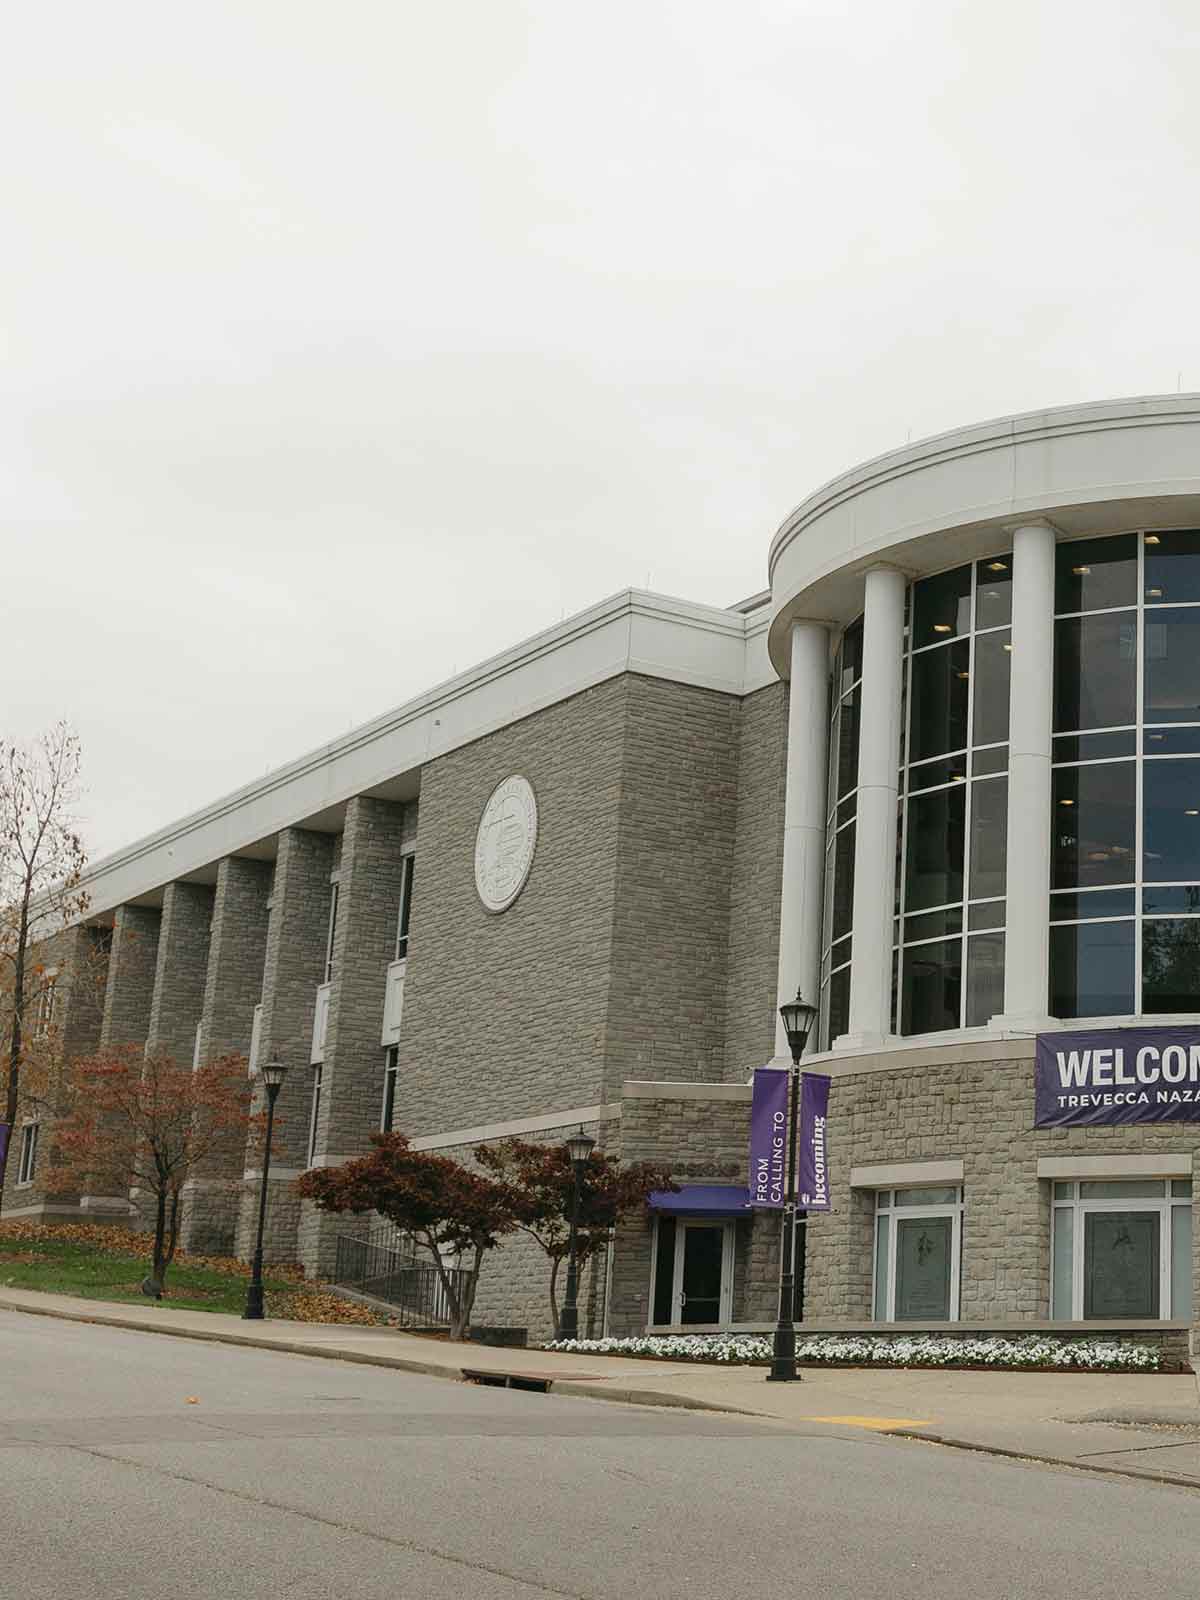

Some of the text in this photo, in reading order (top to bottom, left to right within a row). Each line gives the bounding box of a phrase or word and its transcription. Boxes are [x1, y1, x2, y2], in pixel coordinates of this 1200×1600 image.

[1057, 1092, 1150, 1108] TREVECCA
[757, 1159, 769, 1202] FROM
[770, 1112, 785, 1203] CALLING TO
[811, 1115, 827, 1205] becoming
